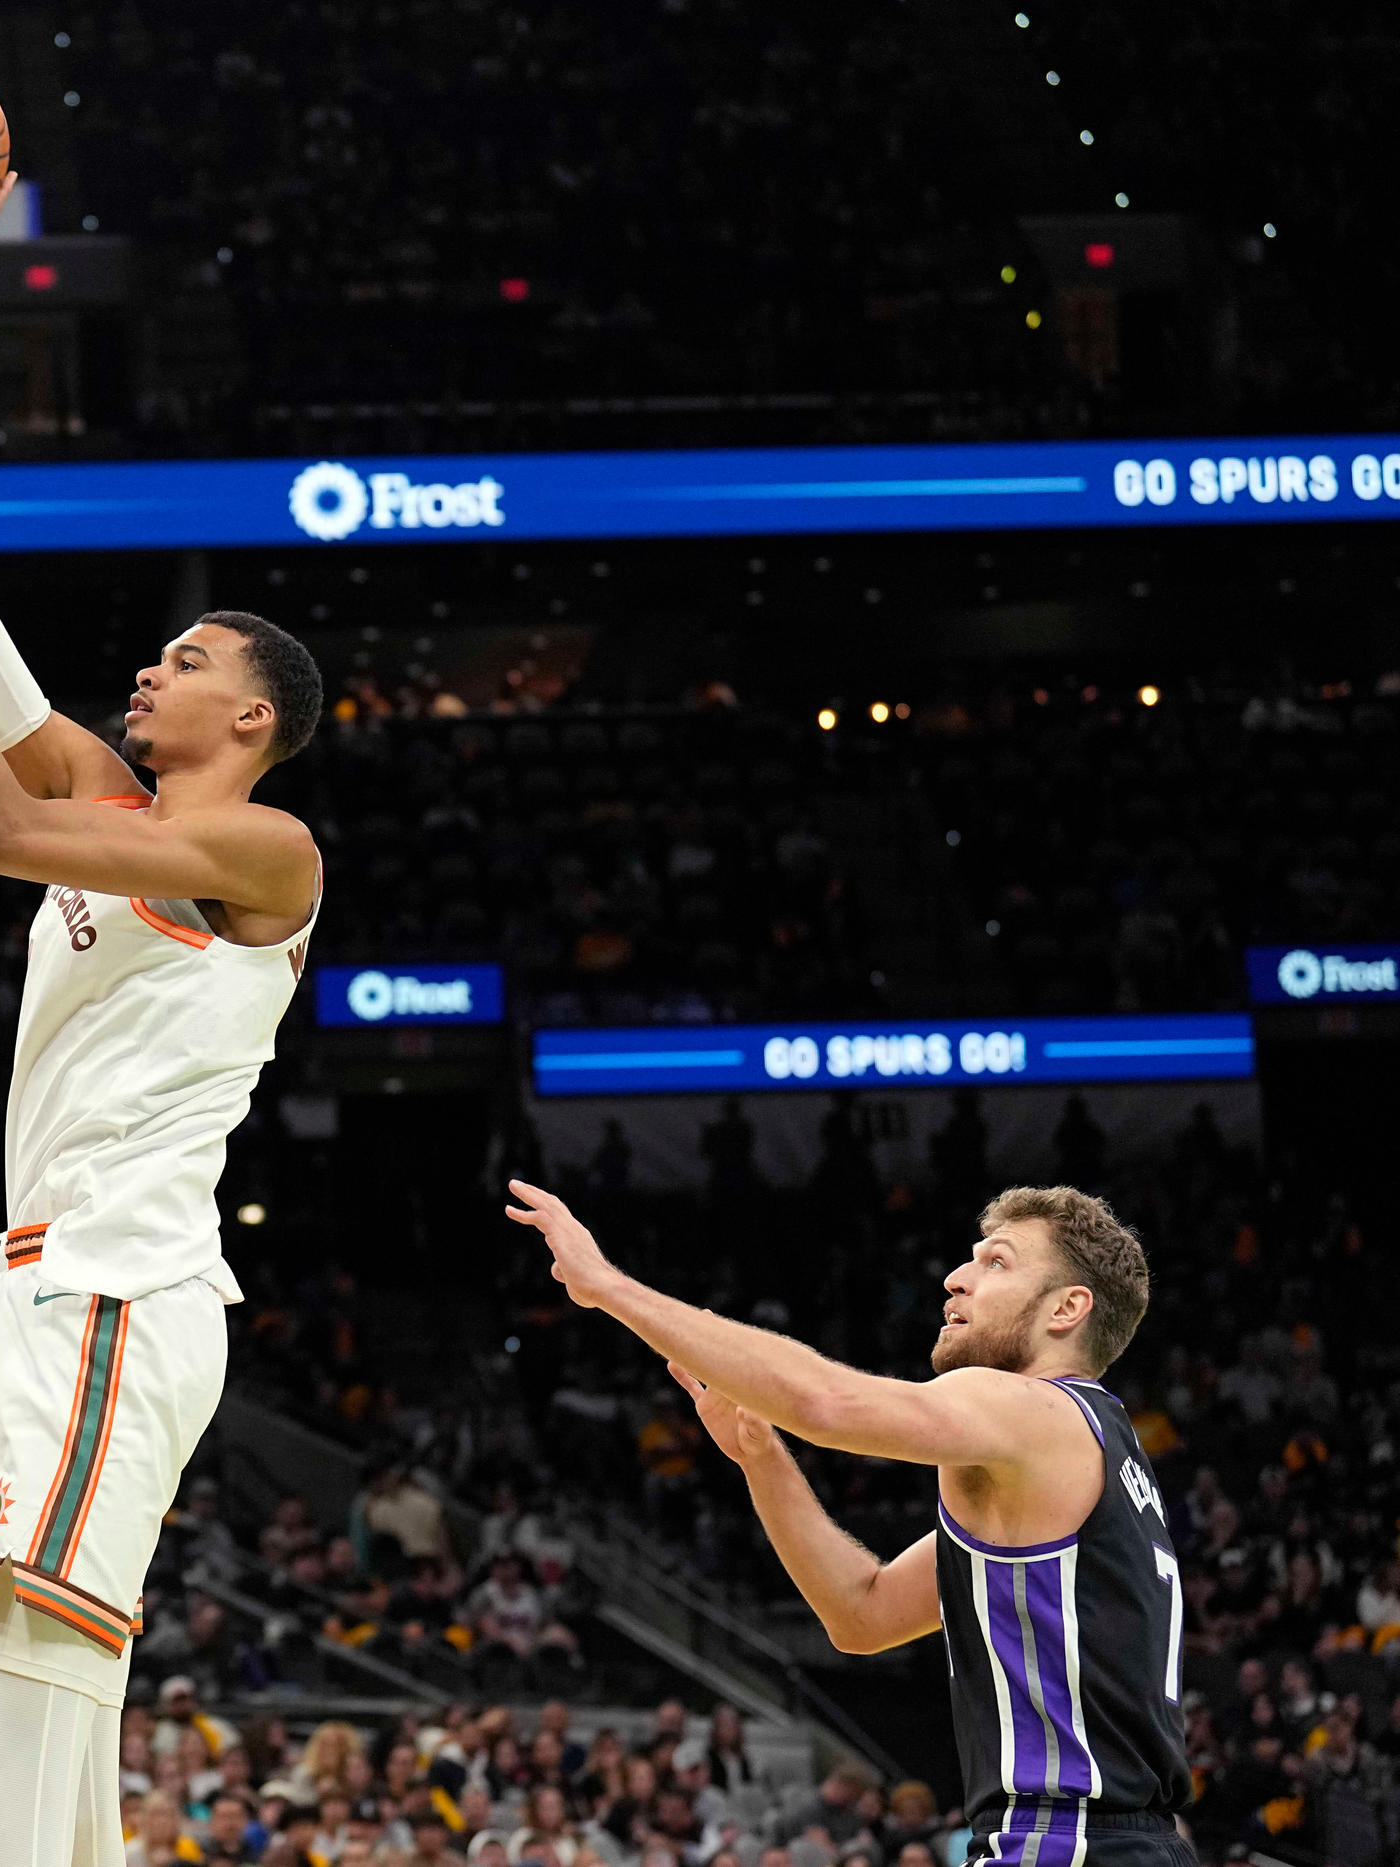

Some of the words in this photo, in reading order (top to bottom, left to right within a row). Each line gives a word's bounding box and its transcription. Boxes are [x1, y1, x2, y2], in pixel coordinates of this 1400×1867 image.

[367, 472, 506, 529] Frost
[1113, 458, 1177, 507] GO
[1189, 454, 1339, 504] SPURS
[1322, 955, 1399, 993] Frost
[764, 1036, 820, 1079] GO
[826, 1033, 953, 1077] SPURS
[959, 1031, 1027, 1074] GO!
[1153, 1542, 1184, 1704] 7
